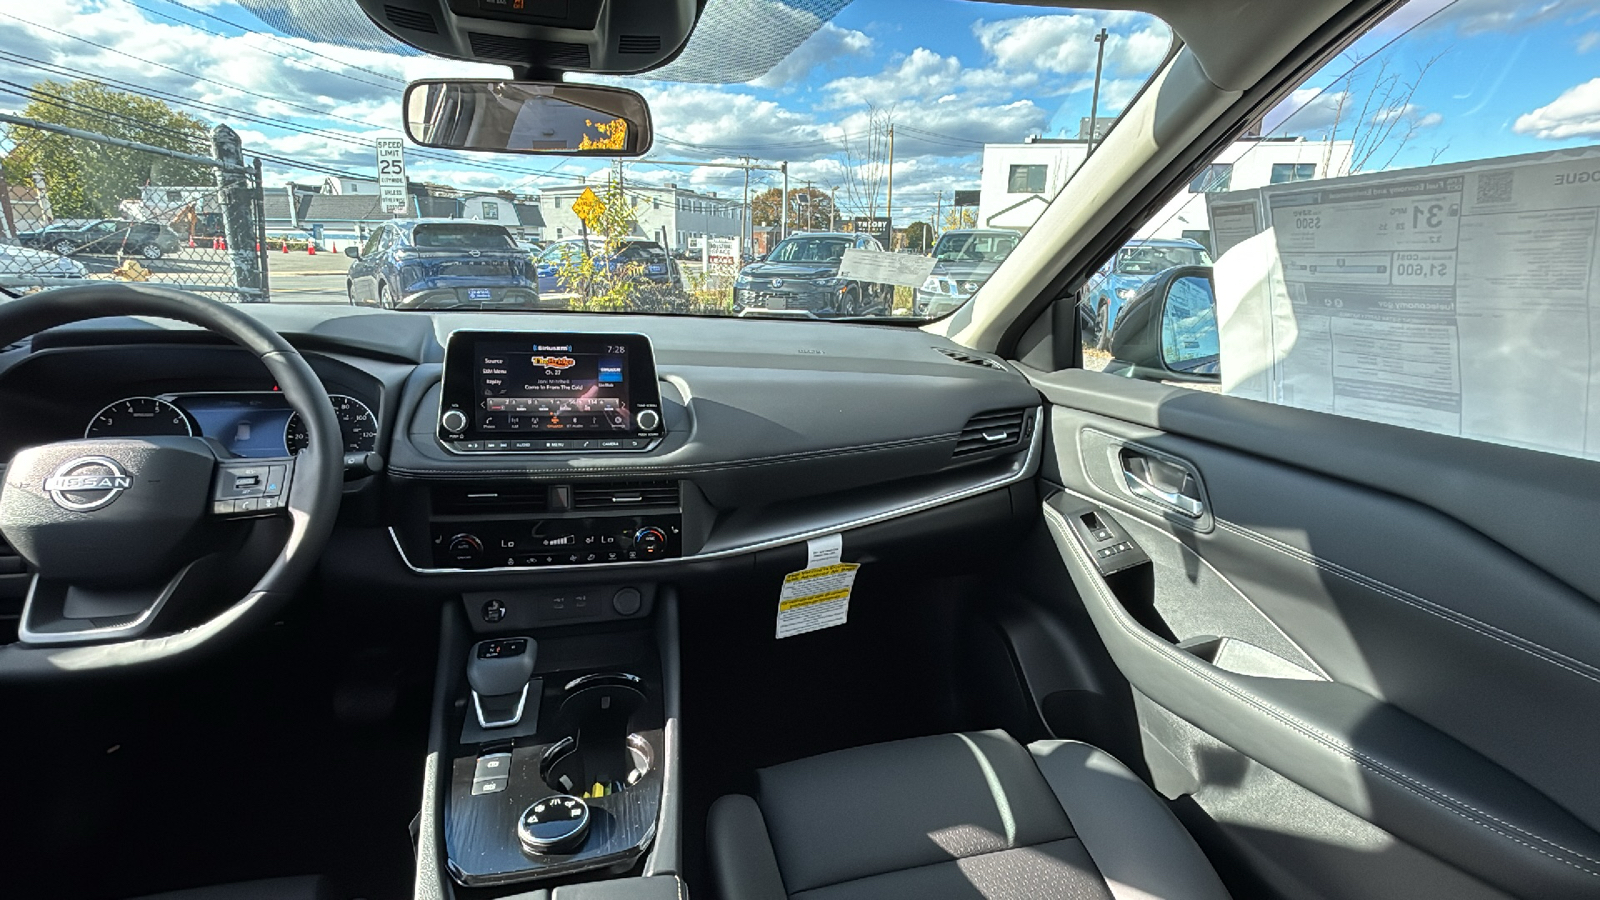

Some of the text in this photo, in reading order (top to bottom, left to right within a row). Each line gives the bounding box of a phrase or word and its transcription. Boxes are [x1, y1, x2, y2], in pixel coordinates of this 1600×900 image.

[380, 160, 403, 175] 25
[607, 345, 626, 354] 7:28
[154, 406, 160, 414] 5
[107, 418, 113, 426] 3
[46, 477, 131, 488] ISSAN
[501, 540, 515, 548] Lo
[601, 536, 614, 544] Lo
